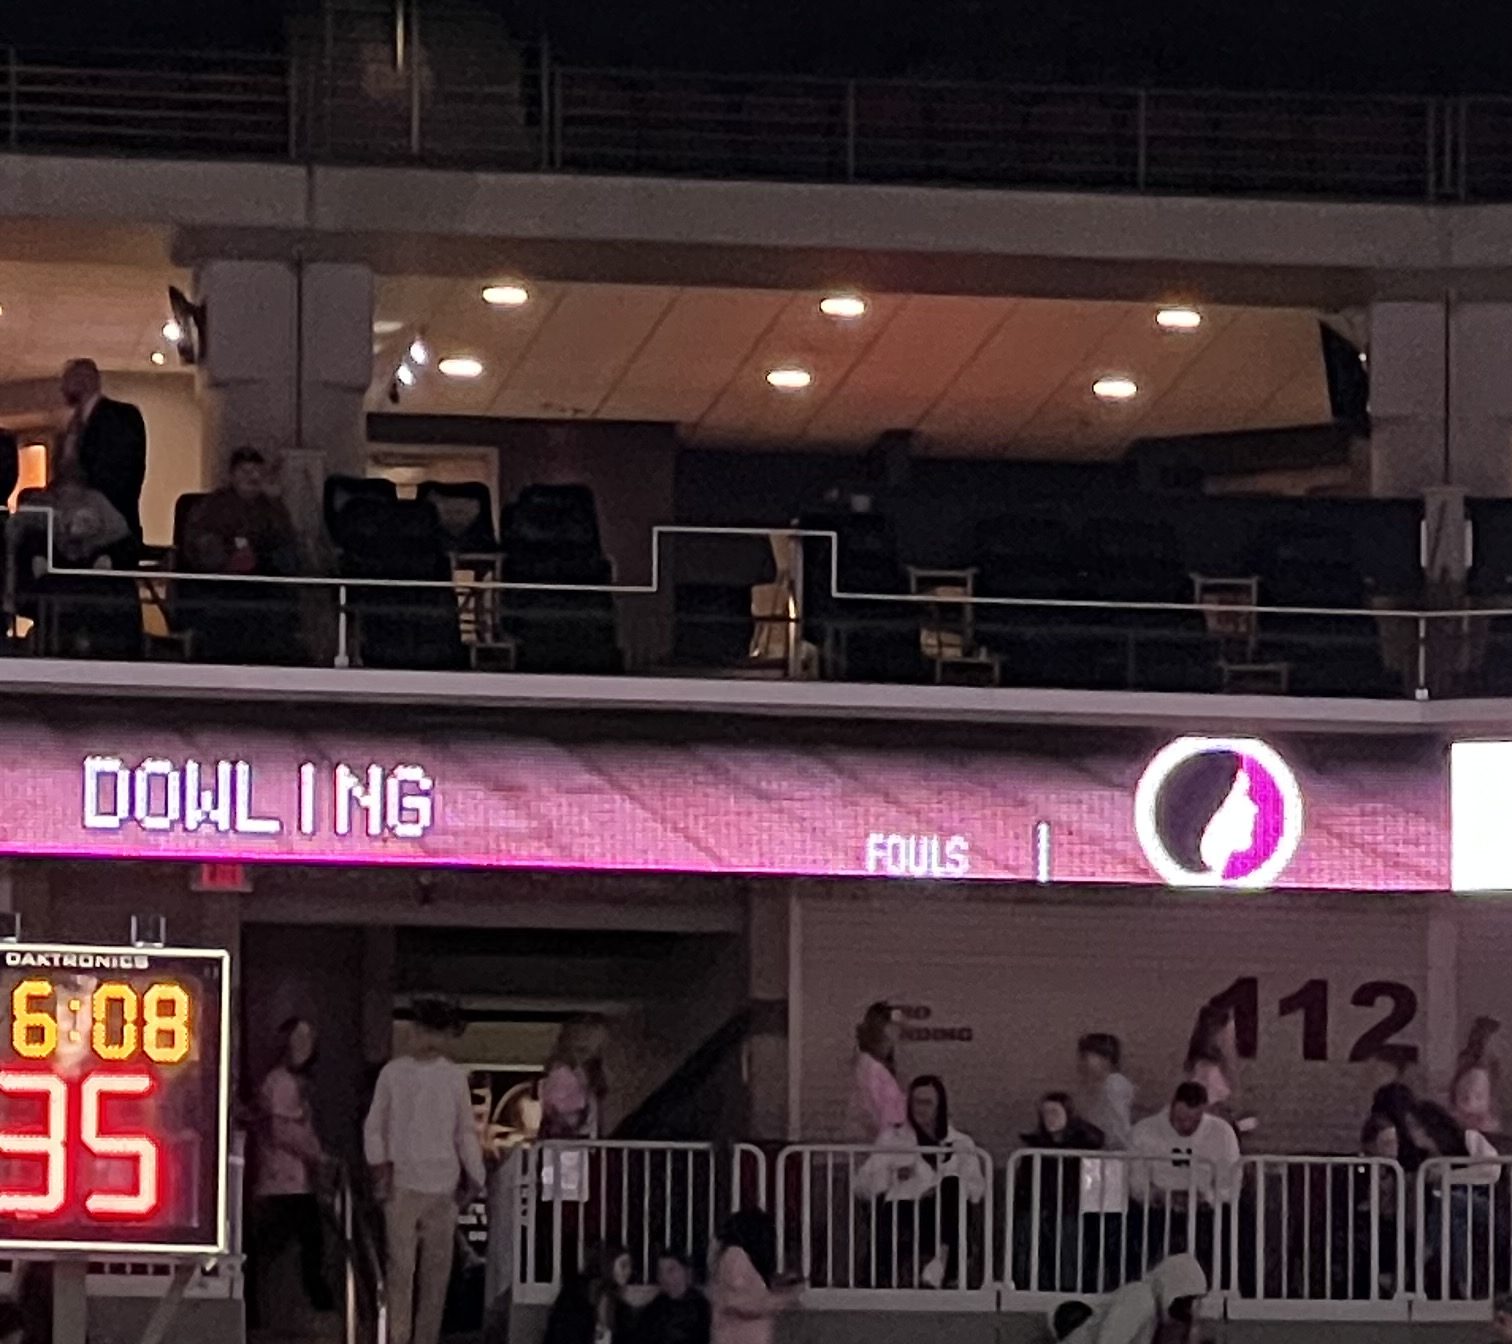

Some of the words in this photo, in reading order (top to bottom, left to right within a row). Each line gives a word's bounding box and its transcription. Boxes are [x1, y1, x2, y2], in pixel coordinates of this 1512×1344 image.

[82, 756, 434, 837] DOWLING
[865, 833, 970, 876] FOULS
[5, 952, 150, 969] DAKTRONICS
[12, 979, 190, 1063] 6:08
[1207, 975, 1419, 1063] 112
[0, 1073, 158, 1214] 35
